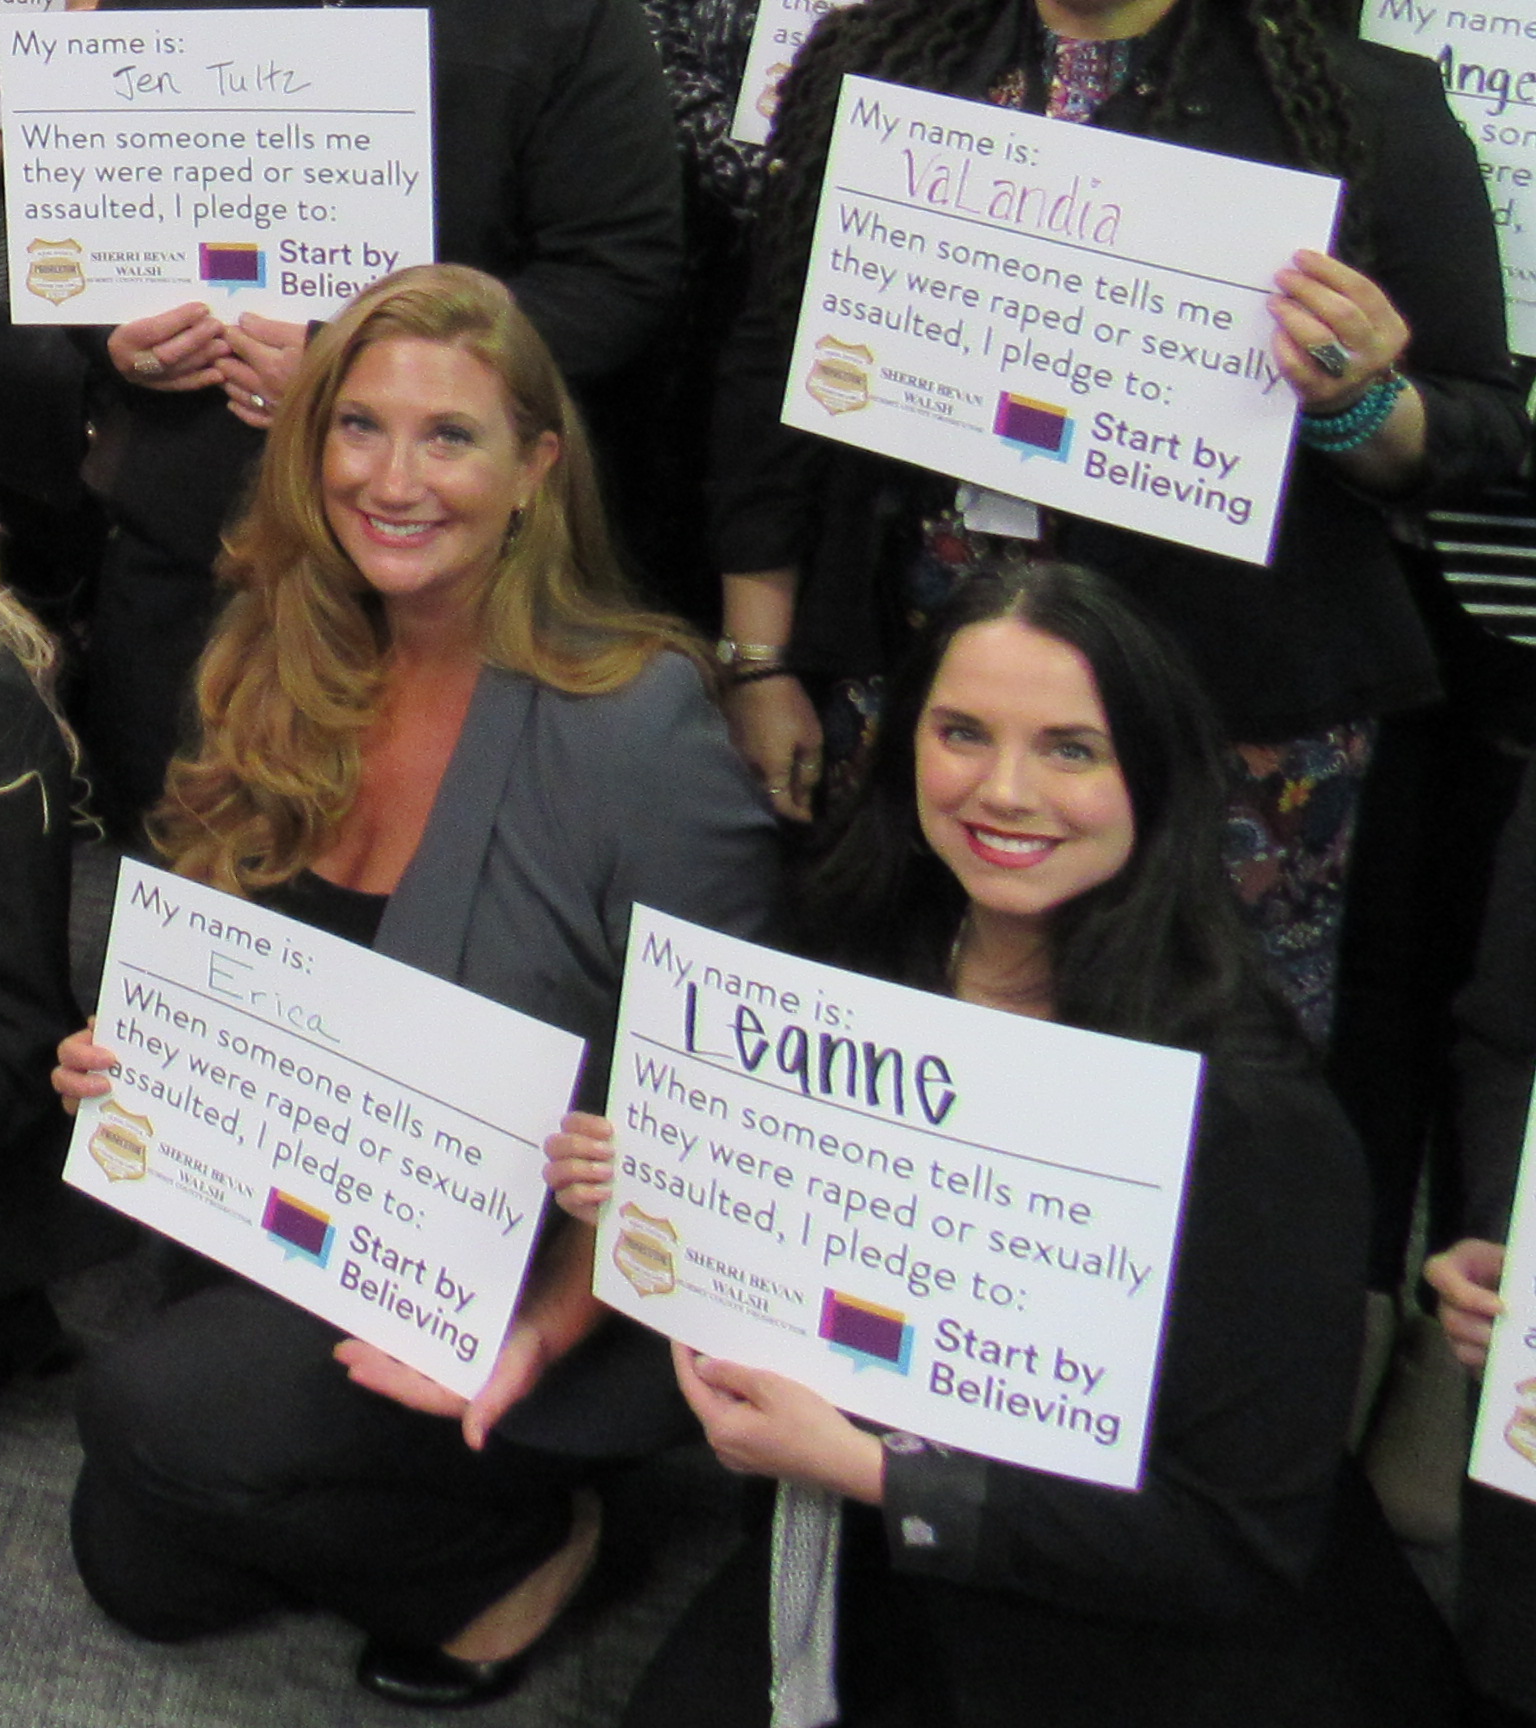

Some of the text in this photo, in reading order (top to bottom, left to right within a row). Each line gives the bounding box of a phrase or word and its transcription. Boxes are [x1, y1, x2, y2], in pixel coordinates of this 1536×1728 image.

[12, 29, 184, 64] My name is:
[113, 65, 182, 101] Jen
[21, 123, 370, 151] When someone tells me
[22, 156, 419, 196] they were raped or sexually
[24, 192, 335, 229] assaulted, I pledge to:
[90, 251, 185, 262] SHERRI BEVAN
[115, 266, 161, 276] WALSH
[279, 238, 404, 276] Start by
[207, 949, 341, 1044] Erica
[681, 983, 959, 1126] Leanne
